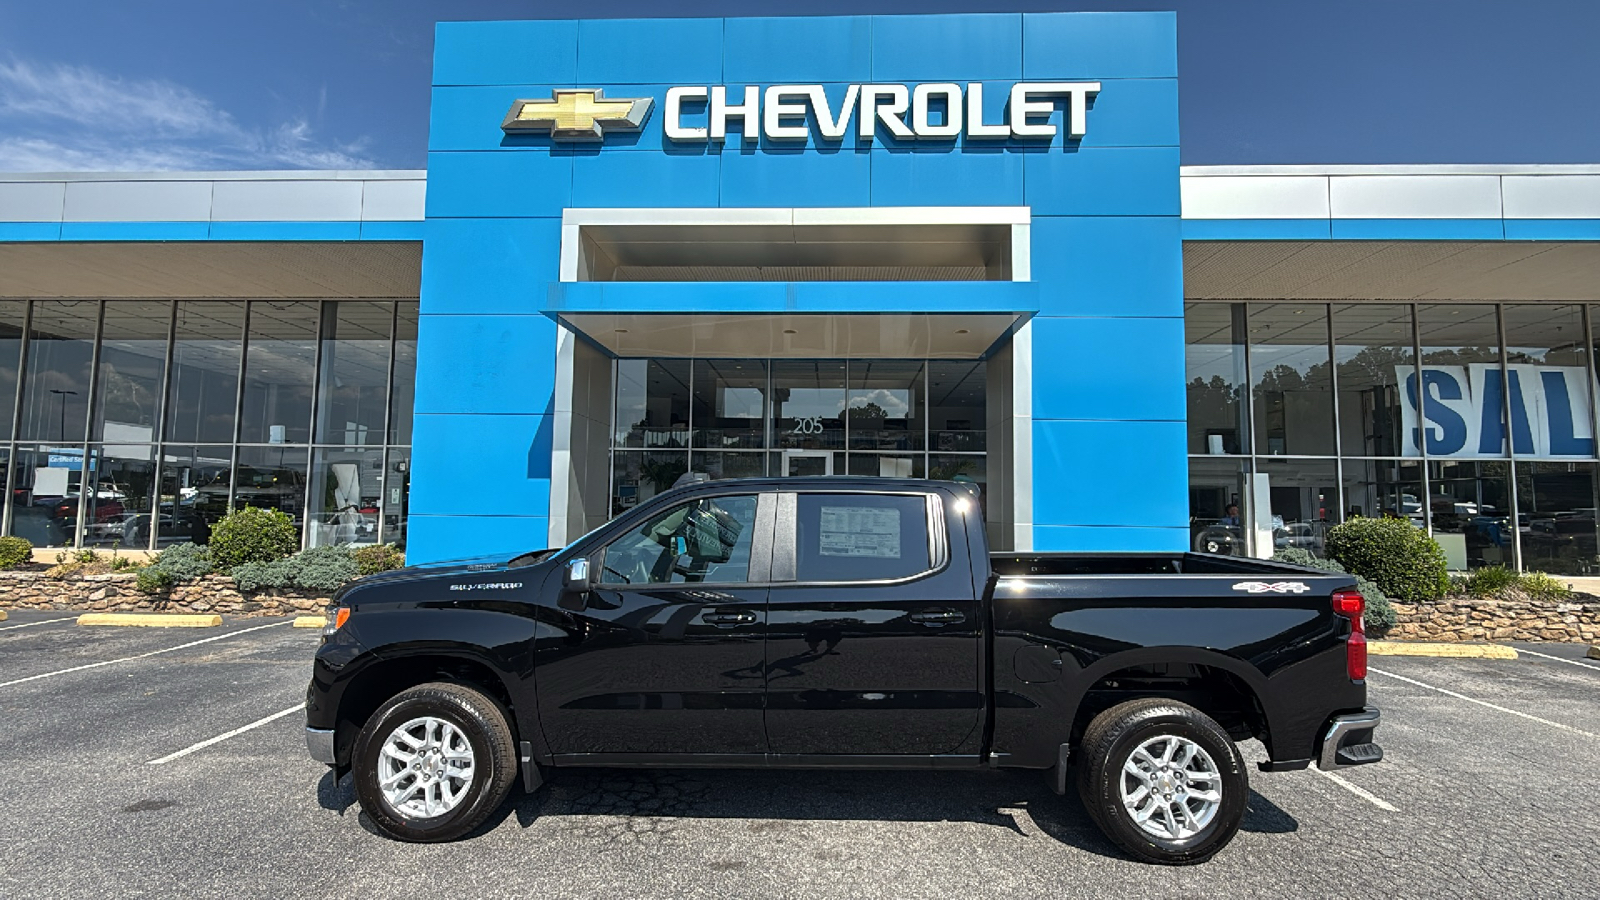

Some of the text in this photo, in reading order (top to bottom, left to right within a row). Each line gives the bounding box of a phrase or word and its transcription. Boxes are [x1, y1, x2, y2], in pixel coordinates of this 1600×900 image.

[664, 82, 1101, 141] CHEVROLET
[793, 418, 824, 434] 205
[449, 582, 523, 591] SILVERADO
